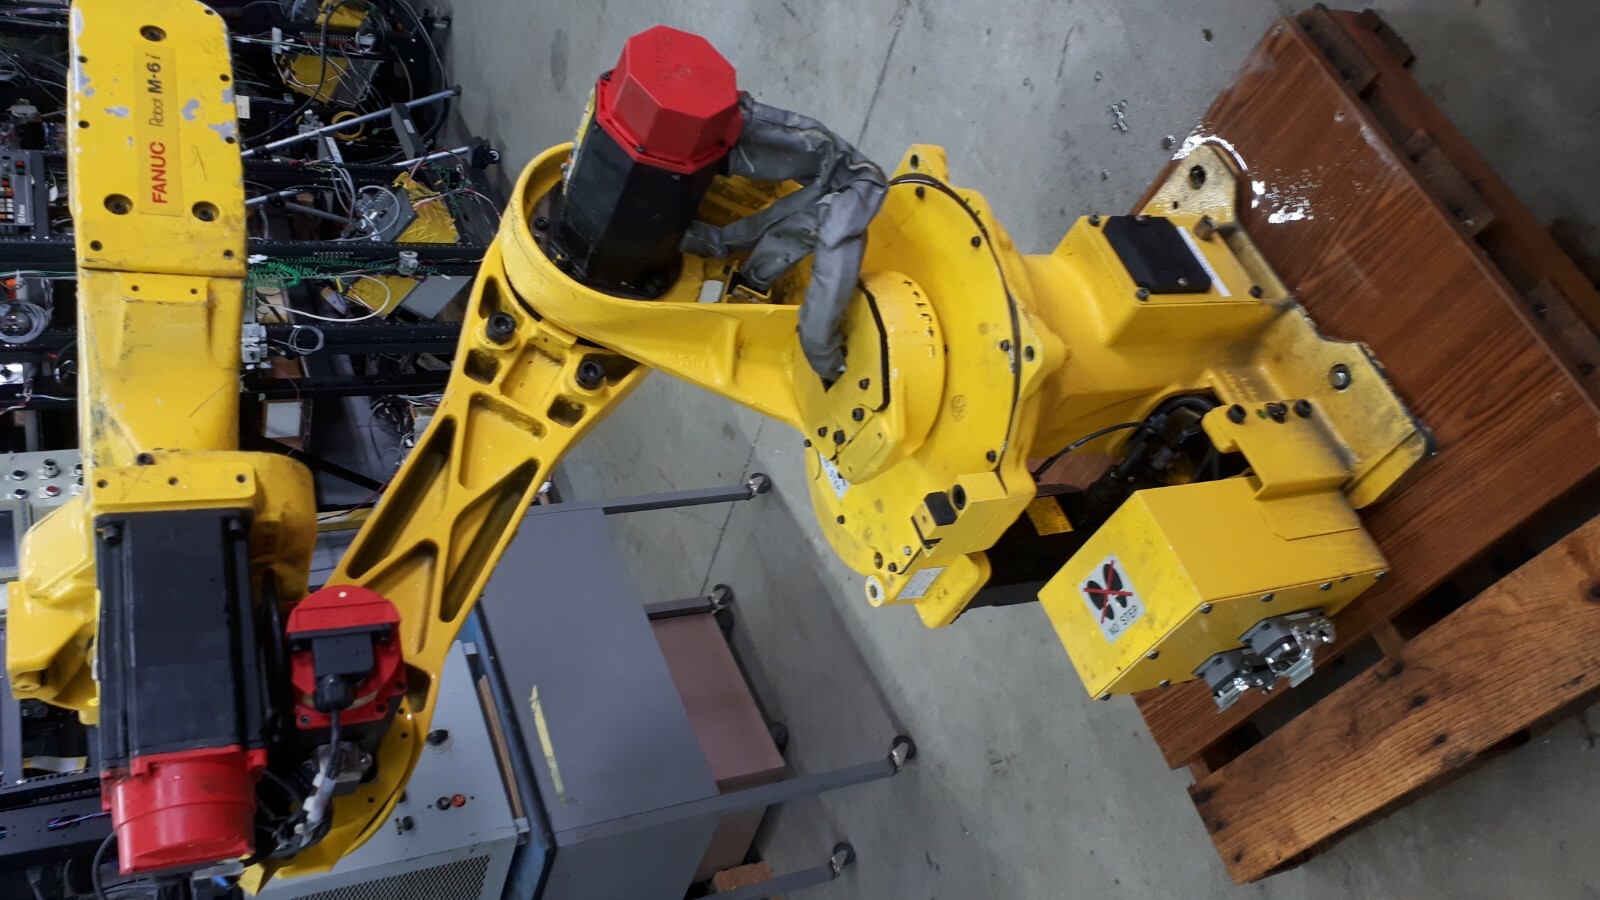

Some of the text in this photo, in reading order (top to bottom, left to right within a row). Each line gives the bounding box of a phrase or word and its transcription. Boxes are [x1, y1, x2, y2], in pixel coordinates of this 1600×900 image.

[149, 98, 164, 127] Robot
[149, 141, 168, 204] FANUC
[1108, 604, 1138, 635] NO STEP
